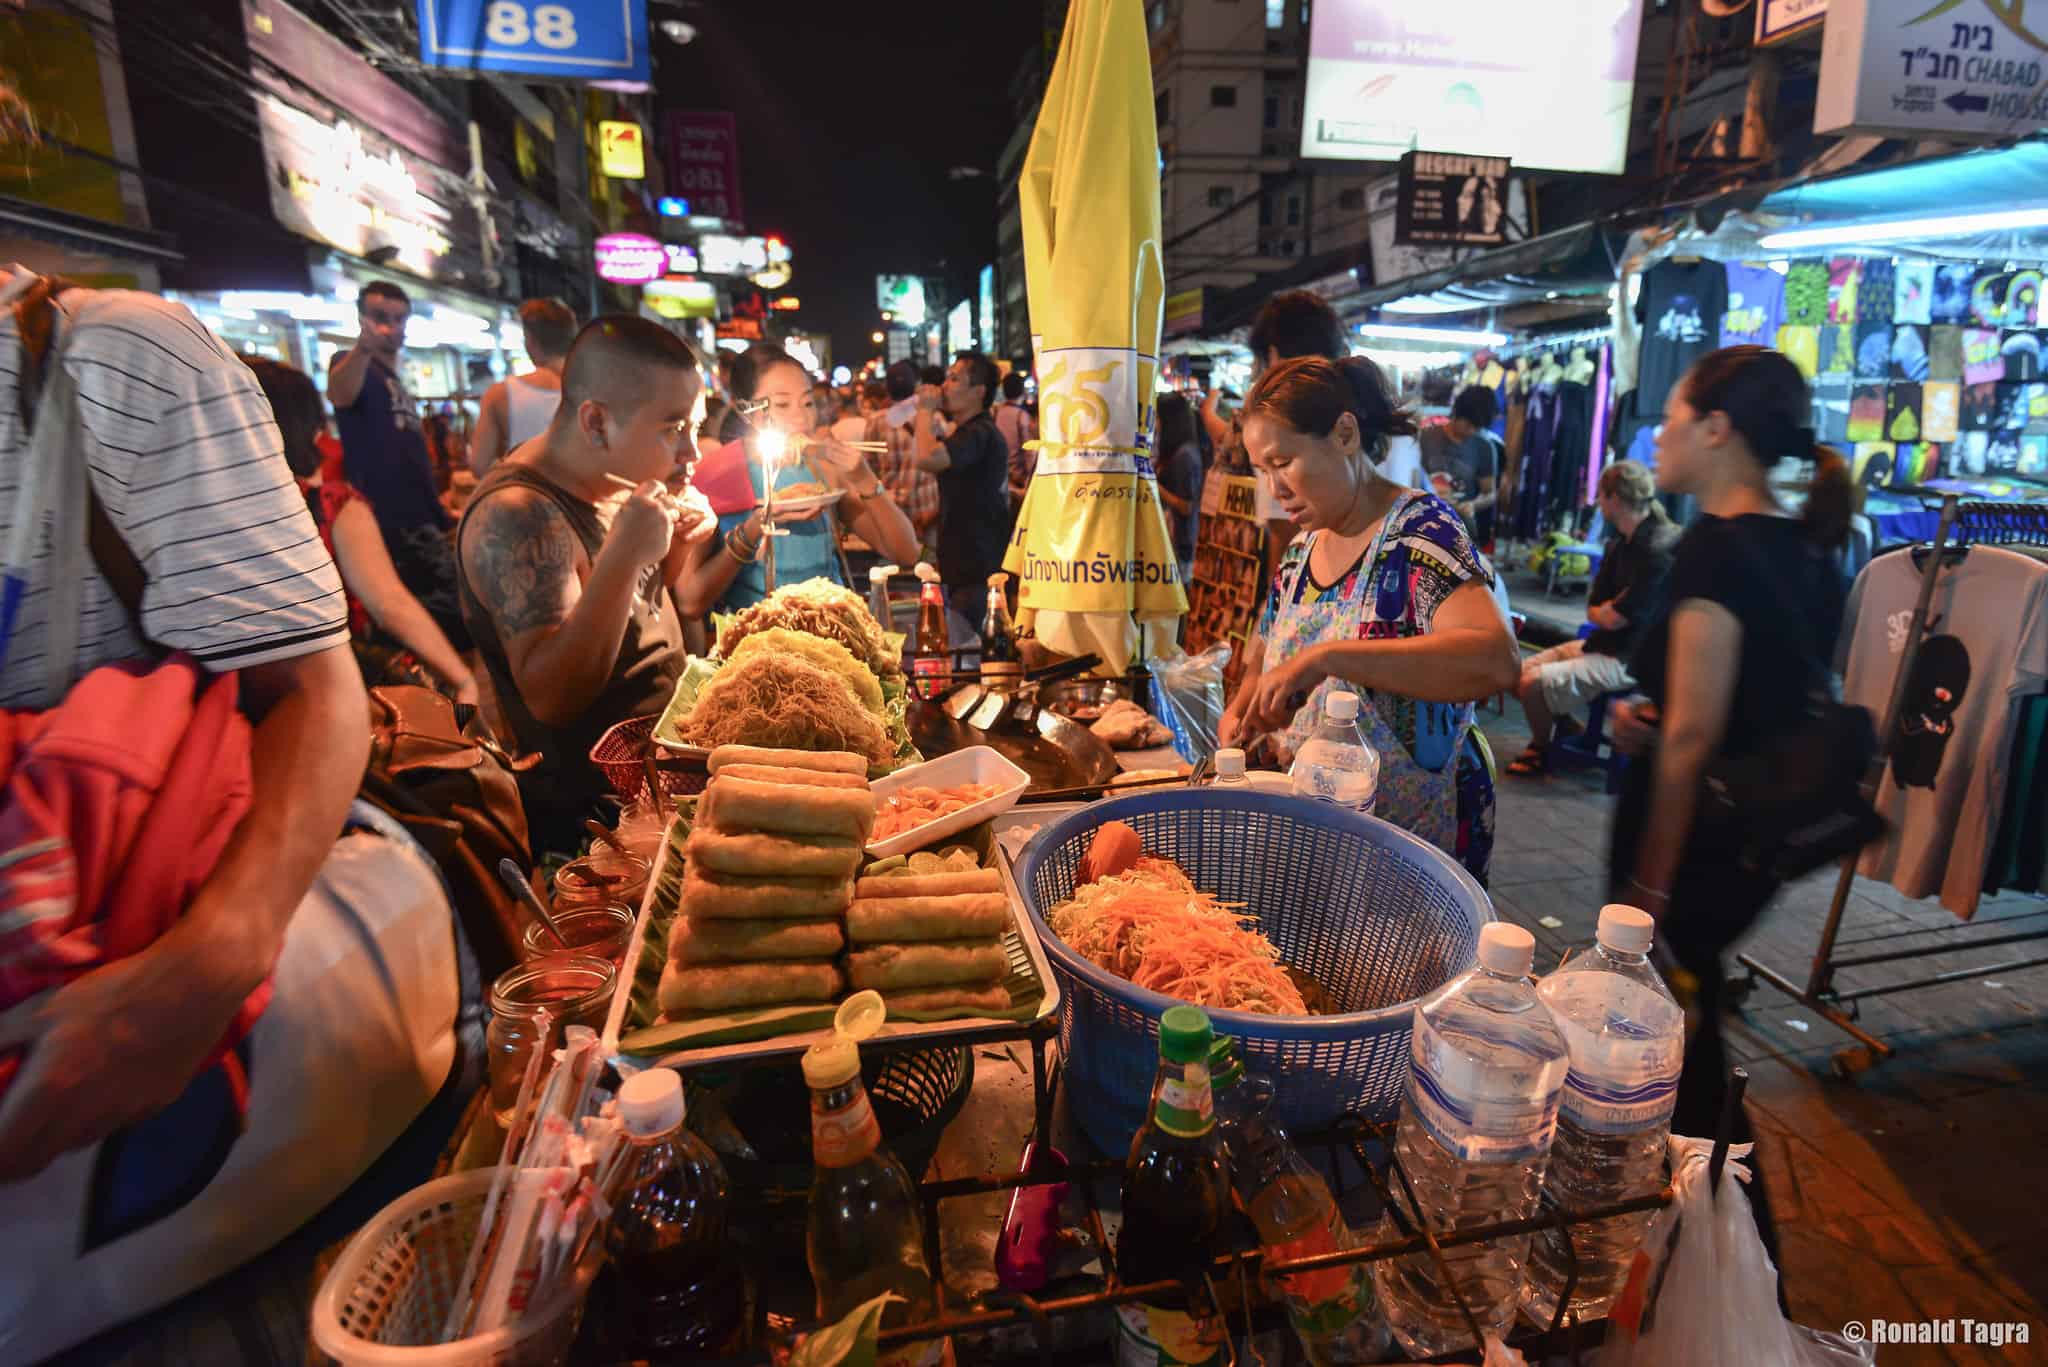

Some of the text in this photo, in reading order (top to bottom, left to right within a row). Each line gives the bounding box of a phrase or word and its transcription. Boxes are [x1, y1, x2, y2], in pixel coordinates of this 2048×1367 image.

[486, 1, 578, 49] 88
[1950, 22, 1994, 52] בית
[1964, 56, 2041, 88] CHABAD
